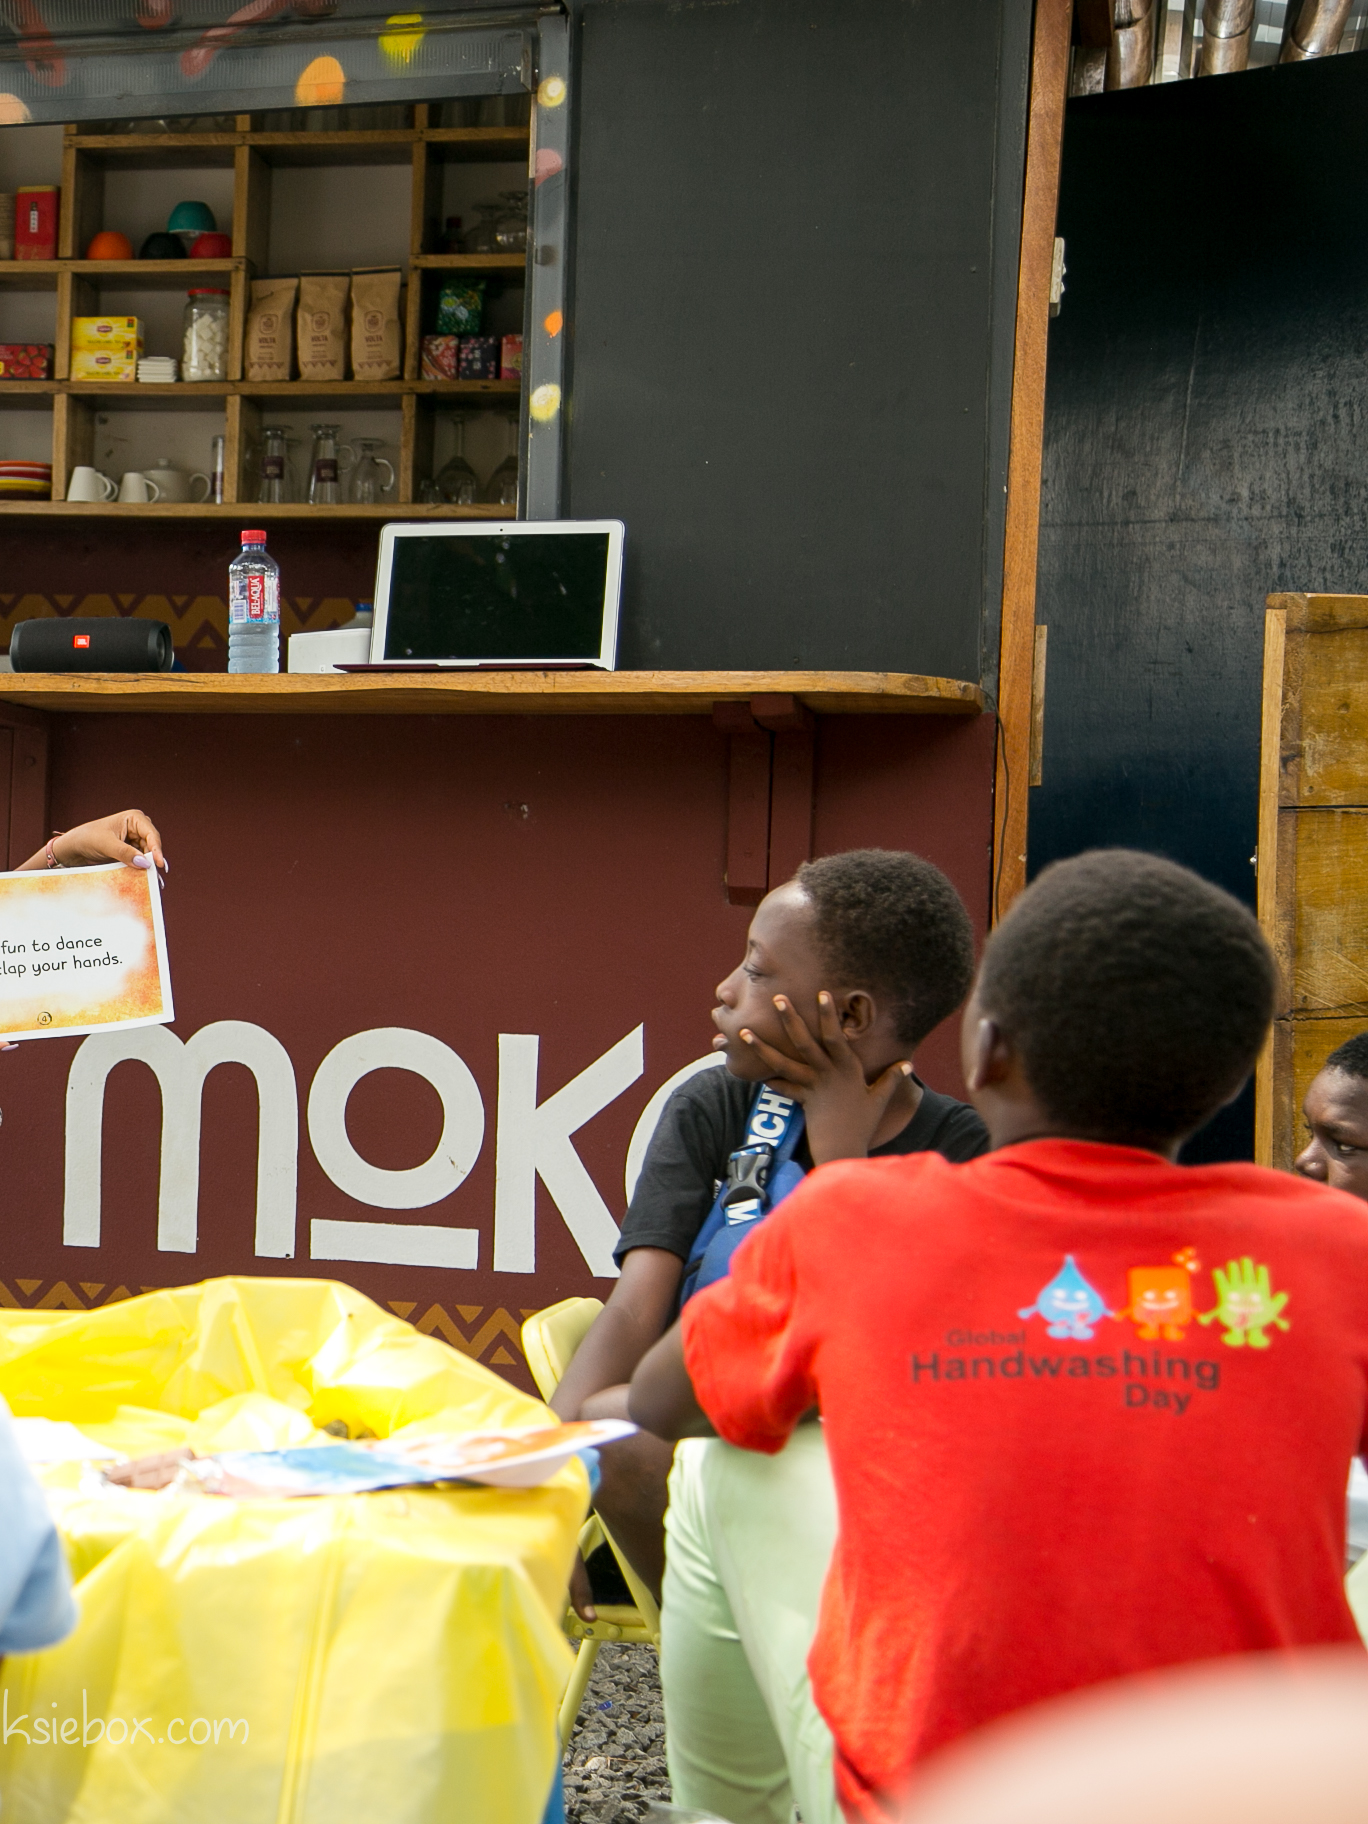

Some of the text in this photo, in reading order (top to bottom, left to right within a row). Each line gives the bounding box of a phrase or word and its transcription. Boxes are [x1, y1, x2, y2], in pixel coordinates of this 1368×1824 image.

[0, 940, 26, 954] fun
[31, 939, 50, 952] to
[55, 936, 103, 950] dance
[31, 960, 68, 976] your
[72, 951, 123, 969] hands.
[944, 1329, 1026, 1347] Global
[911, 1349, 1221, 1391] Handwashing
[1123, 1383, 1192, 1416] Day
